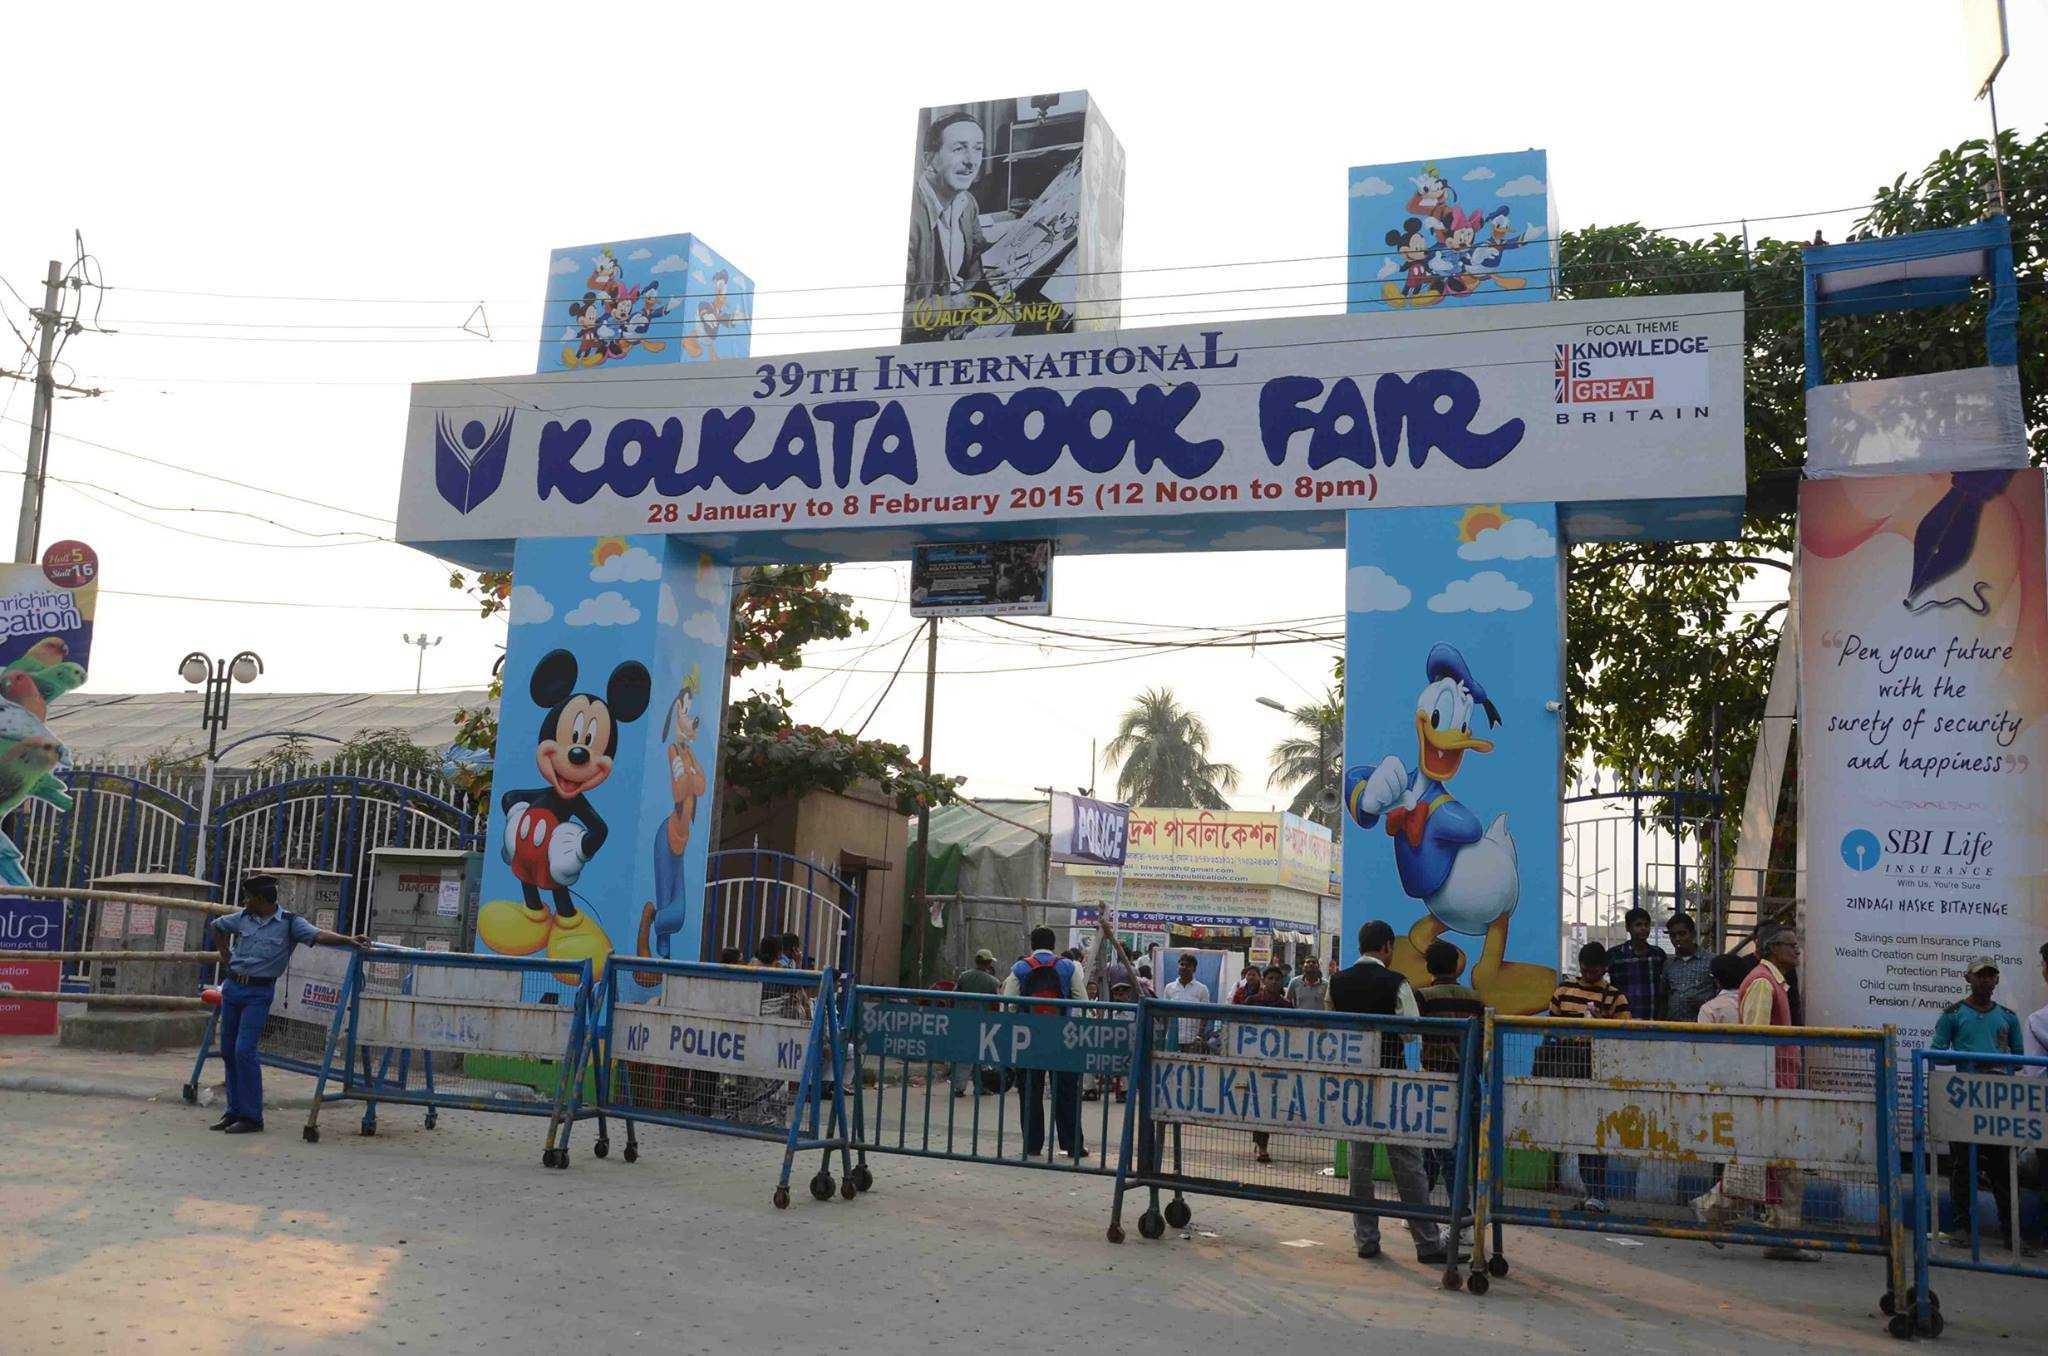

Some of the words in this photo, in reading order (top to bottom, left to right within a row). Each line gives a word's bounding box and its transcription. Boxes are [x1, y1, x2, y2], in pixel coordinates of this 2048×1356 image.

[1586, 324, 1631, 336] FOCAL
[1636, 320, 1680, 333] THEME
[1572, 336, 1709, 359] KNOWLEDGE
[753, 361, 859, 398] 39TH
[875, 331, 1239, 390] INTERNATIONAL
[1572, 361, 1591, 378] IS
[1575, 380, 1651, 400] GREAT
[1556, 406, 1709, 424] BRITAIN
[537, 400, 918, 504] KOLKATA
[945, 381, 1224, 479] BOOK
[1259, 369, 1525, 469] FAIR
[648, 503, 678, 523] 28
[687, 500, 797, 524] January
[806, 498, 834, 517] to
[843, 495, 859, 515] 8
[870, 493, 1000, 516] February
[1010, 485, 1084, 508] 2015
[1095, 482, 1144, 510] (12
[1156, 480, 1238, 502] Noon
[1250, 478, 1282, 500] to
[1294, 473, 1378, 502] 8pm)
[72, 549, 84, 562] 5
[73, 563, 94, 577] 16
[1879, 645, 1936, 674] your
[1944, 636, 2013, 668] future
[1879, 676, 1924, 698] with
[1933, 676, 1967, 698] the
[1828, 710, 1894, 745] surety
[1902, 708, 1925, 739] of
[1934, 710, 2023, 747] security
[1847, 748, 1890, 770] and
[1078, 806, 1125, 860] POLICE
[1885, 828, 1934, 855] SBI
[1941, 830, 1994, 865] Life
[1885, 864, 1993, 876] INSURANCE
[1897, 879, 1915, 887] With
[1934, 880, 1959, 889] You're
[1962, 881, 1981, 890] Sure
[1846, 897, 1893, 911] ZINDAGI
[1899, 899, 1935, 913] HASKE
[1941, 900, 2008, 916] BITAYENGE
[1854, 932, 1893, 945] Savings
[1896, 935, 1918, 945] cum
[1921, 935, 1970, 947] Insurance
[1973, 937, 2001, 949] Plans
[1835, 946, 1868, 958] Wealth
[1871, 948, 1913, 960] Creation
[1916, 952, 1938, 961] cum
[1993, 954, 2023, 966] Plans
[1886, 965, 1938, 977] Protection
[1859, 979, 1885, 991] Child
[1888, 982, 1910, 991] cum
[1913, 981, 1962, 994] Insurance
[1869, 995, 1909, 1008] Pension
[863, 1006, 949, 1036] SKIPPER
[1063, 1020, 1137, 1050] SKIPP
[670, 1025, 746, 1062] POLICE
[884, 1036, 927, 1056] PIPES
[1237, 1026, 1364, 1065] POLICE
[1155, 1062, 1307, 1122] KOLKATA
[1318, 1076, 1449, 1134] POLICE
[1946, 1075, 2048, 1113] SKIPPE
[1973, 1114, 2043, 1140] PIPES
